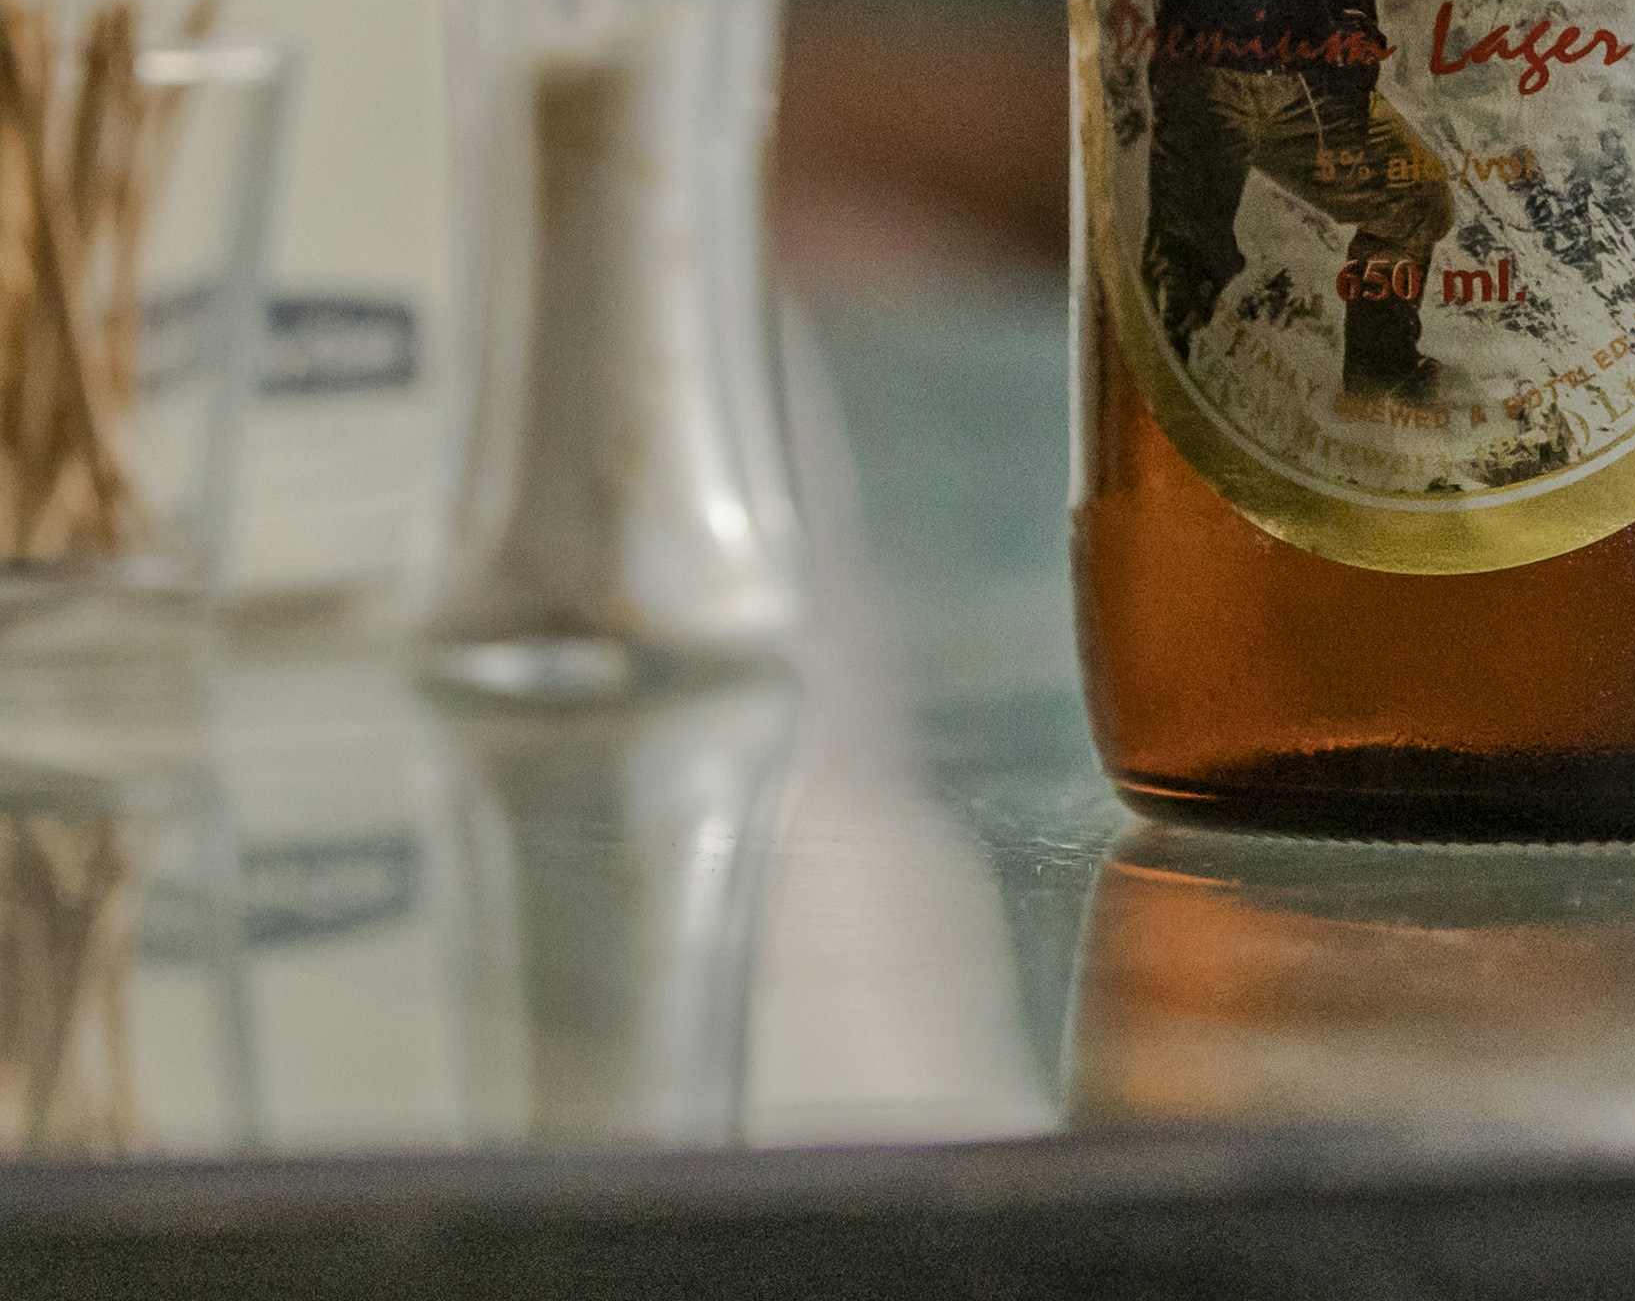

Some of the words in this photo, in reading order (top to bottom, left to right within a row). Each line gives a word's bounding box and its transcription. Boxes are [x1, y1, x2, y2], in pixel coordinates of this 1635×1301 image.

[1428, 1, 1635, 96] Lager
[1335, 252, 1425, 303] 650
[1442, 258, 1527, 303] ml.
